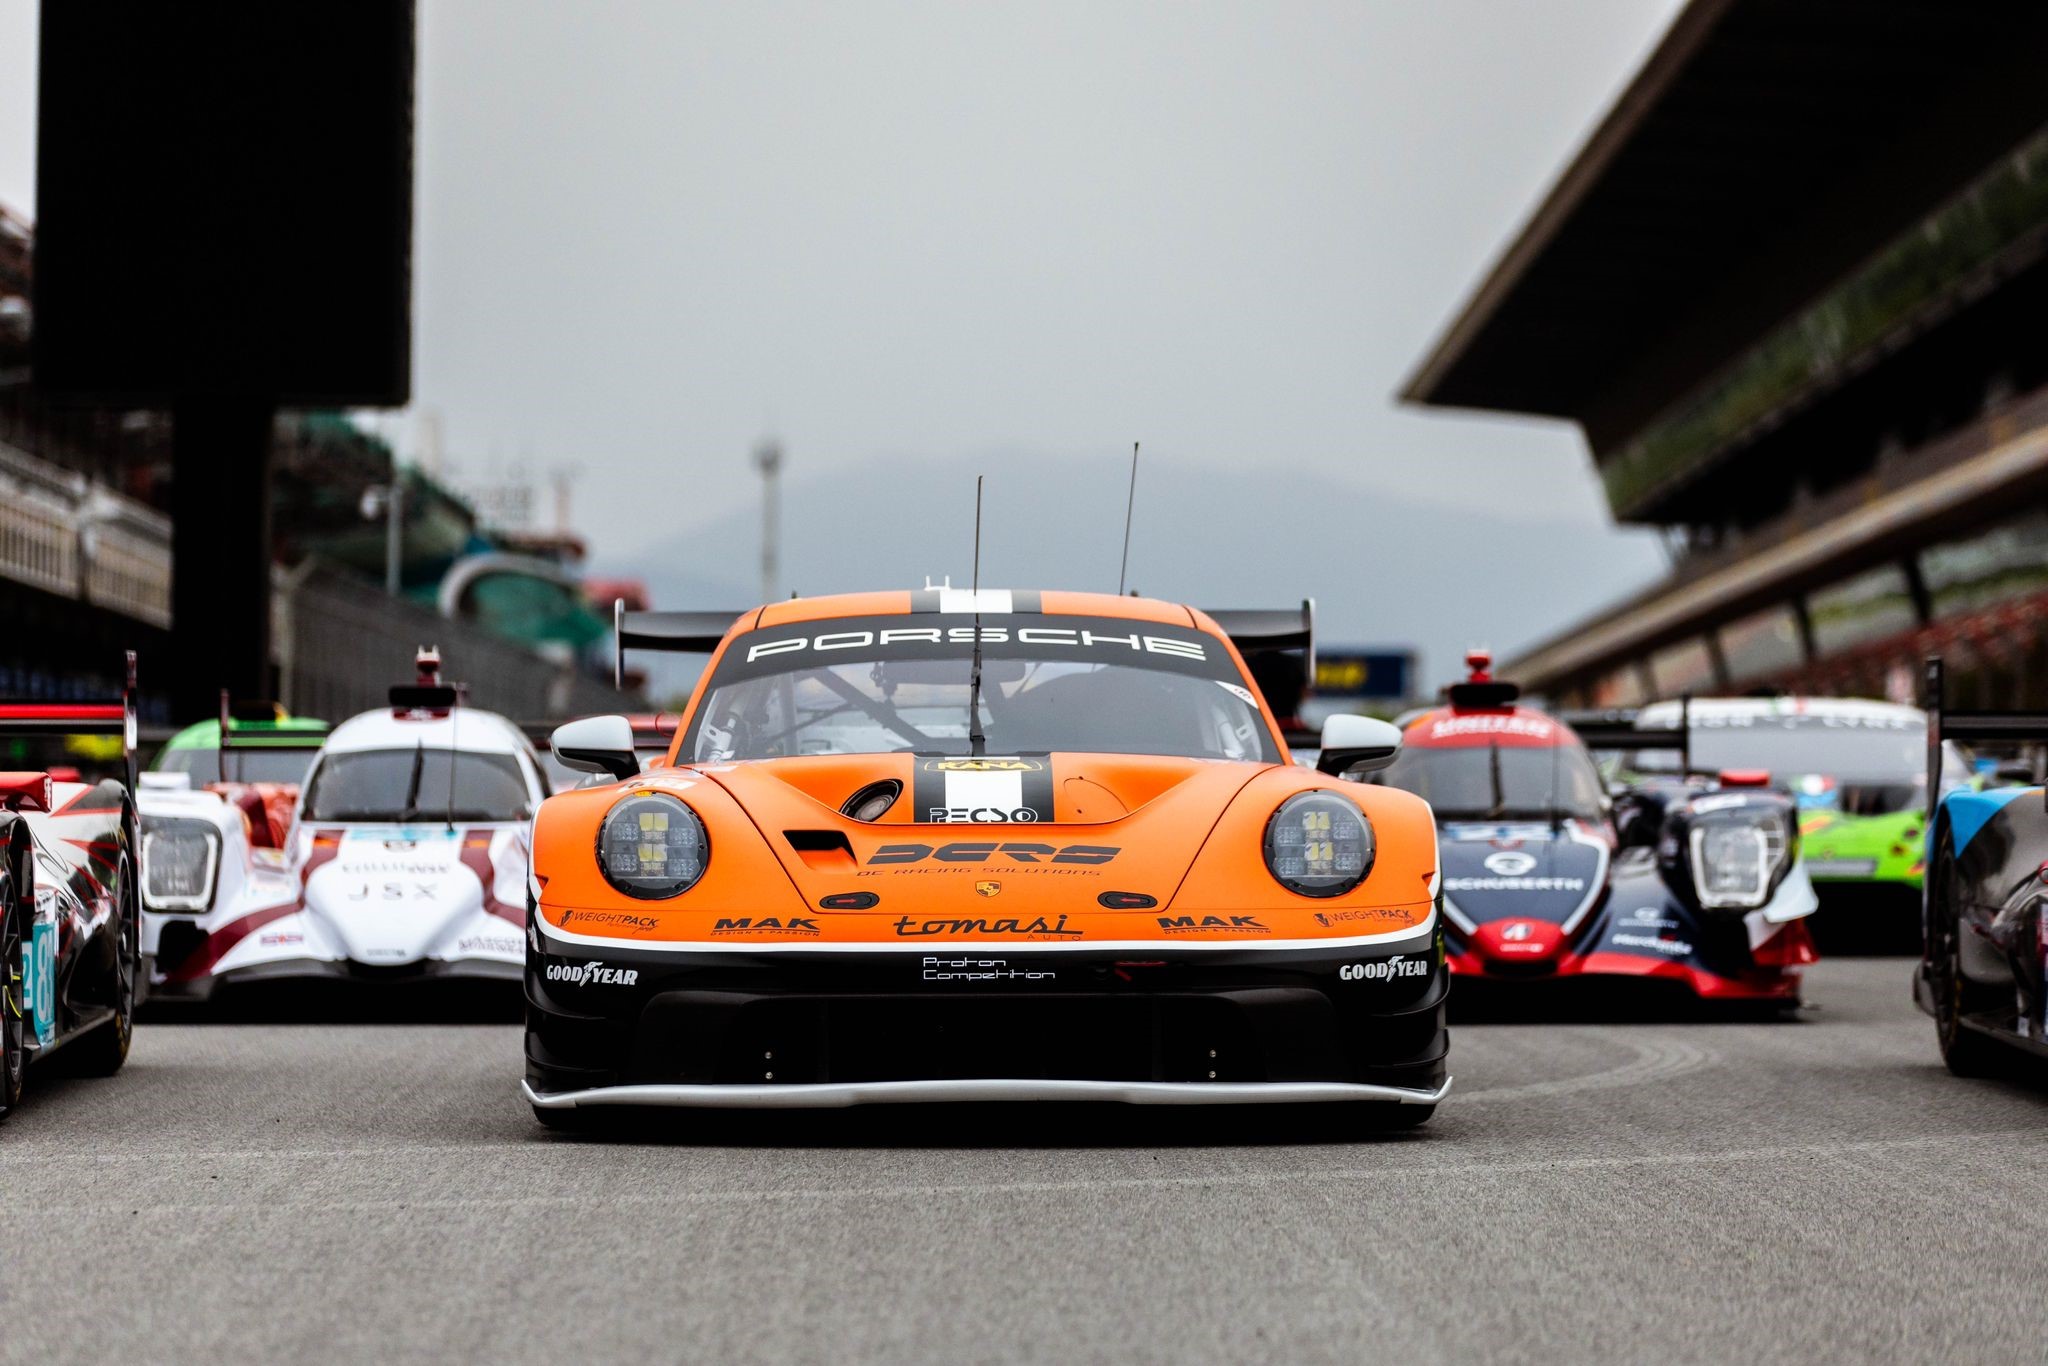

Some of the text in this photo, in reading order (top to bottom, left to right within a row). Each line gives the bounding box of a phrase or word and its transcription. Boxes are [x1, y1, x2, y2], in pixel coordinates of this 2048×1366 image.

[746, 627, 1207, 663] PORSCHE
[929, 807, 1039, 823] PECSO
[894, 866, 973, 875] RACING
[982, 866, 1102, 876] SOLUTIONS
[574, 911, 660, 927] WEIGHTPACK
[1156, 916, 1267, 928] MAK
[1330, 909, 1410, 922] WEIGHTPACK
[714, 917, 820, 931] MAK
[893, 914, 1083, 936] tomasi
[1027, 933, 1082, 942] AUTO
[923, 957, 1006, 967] Proton
[923, 969, 1056, 981] Competition
